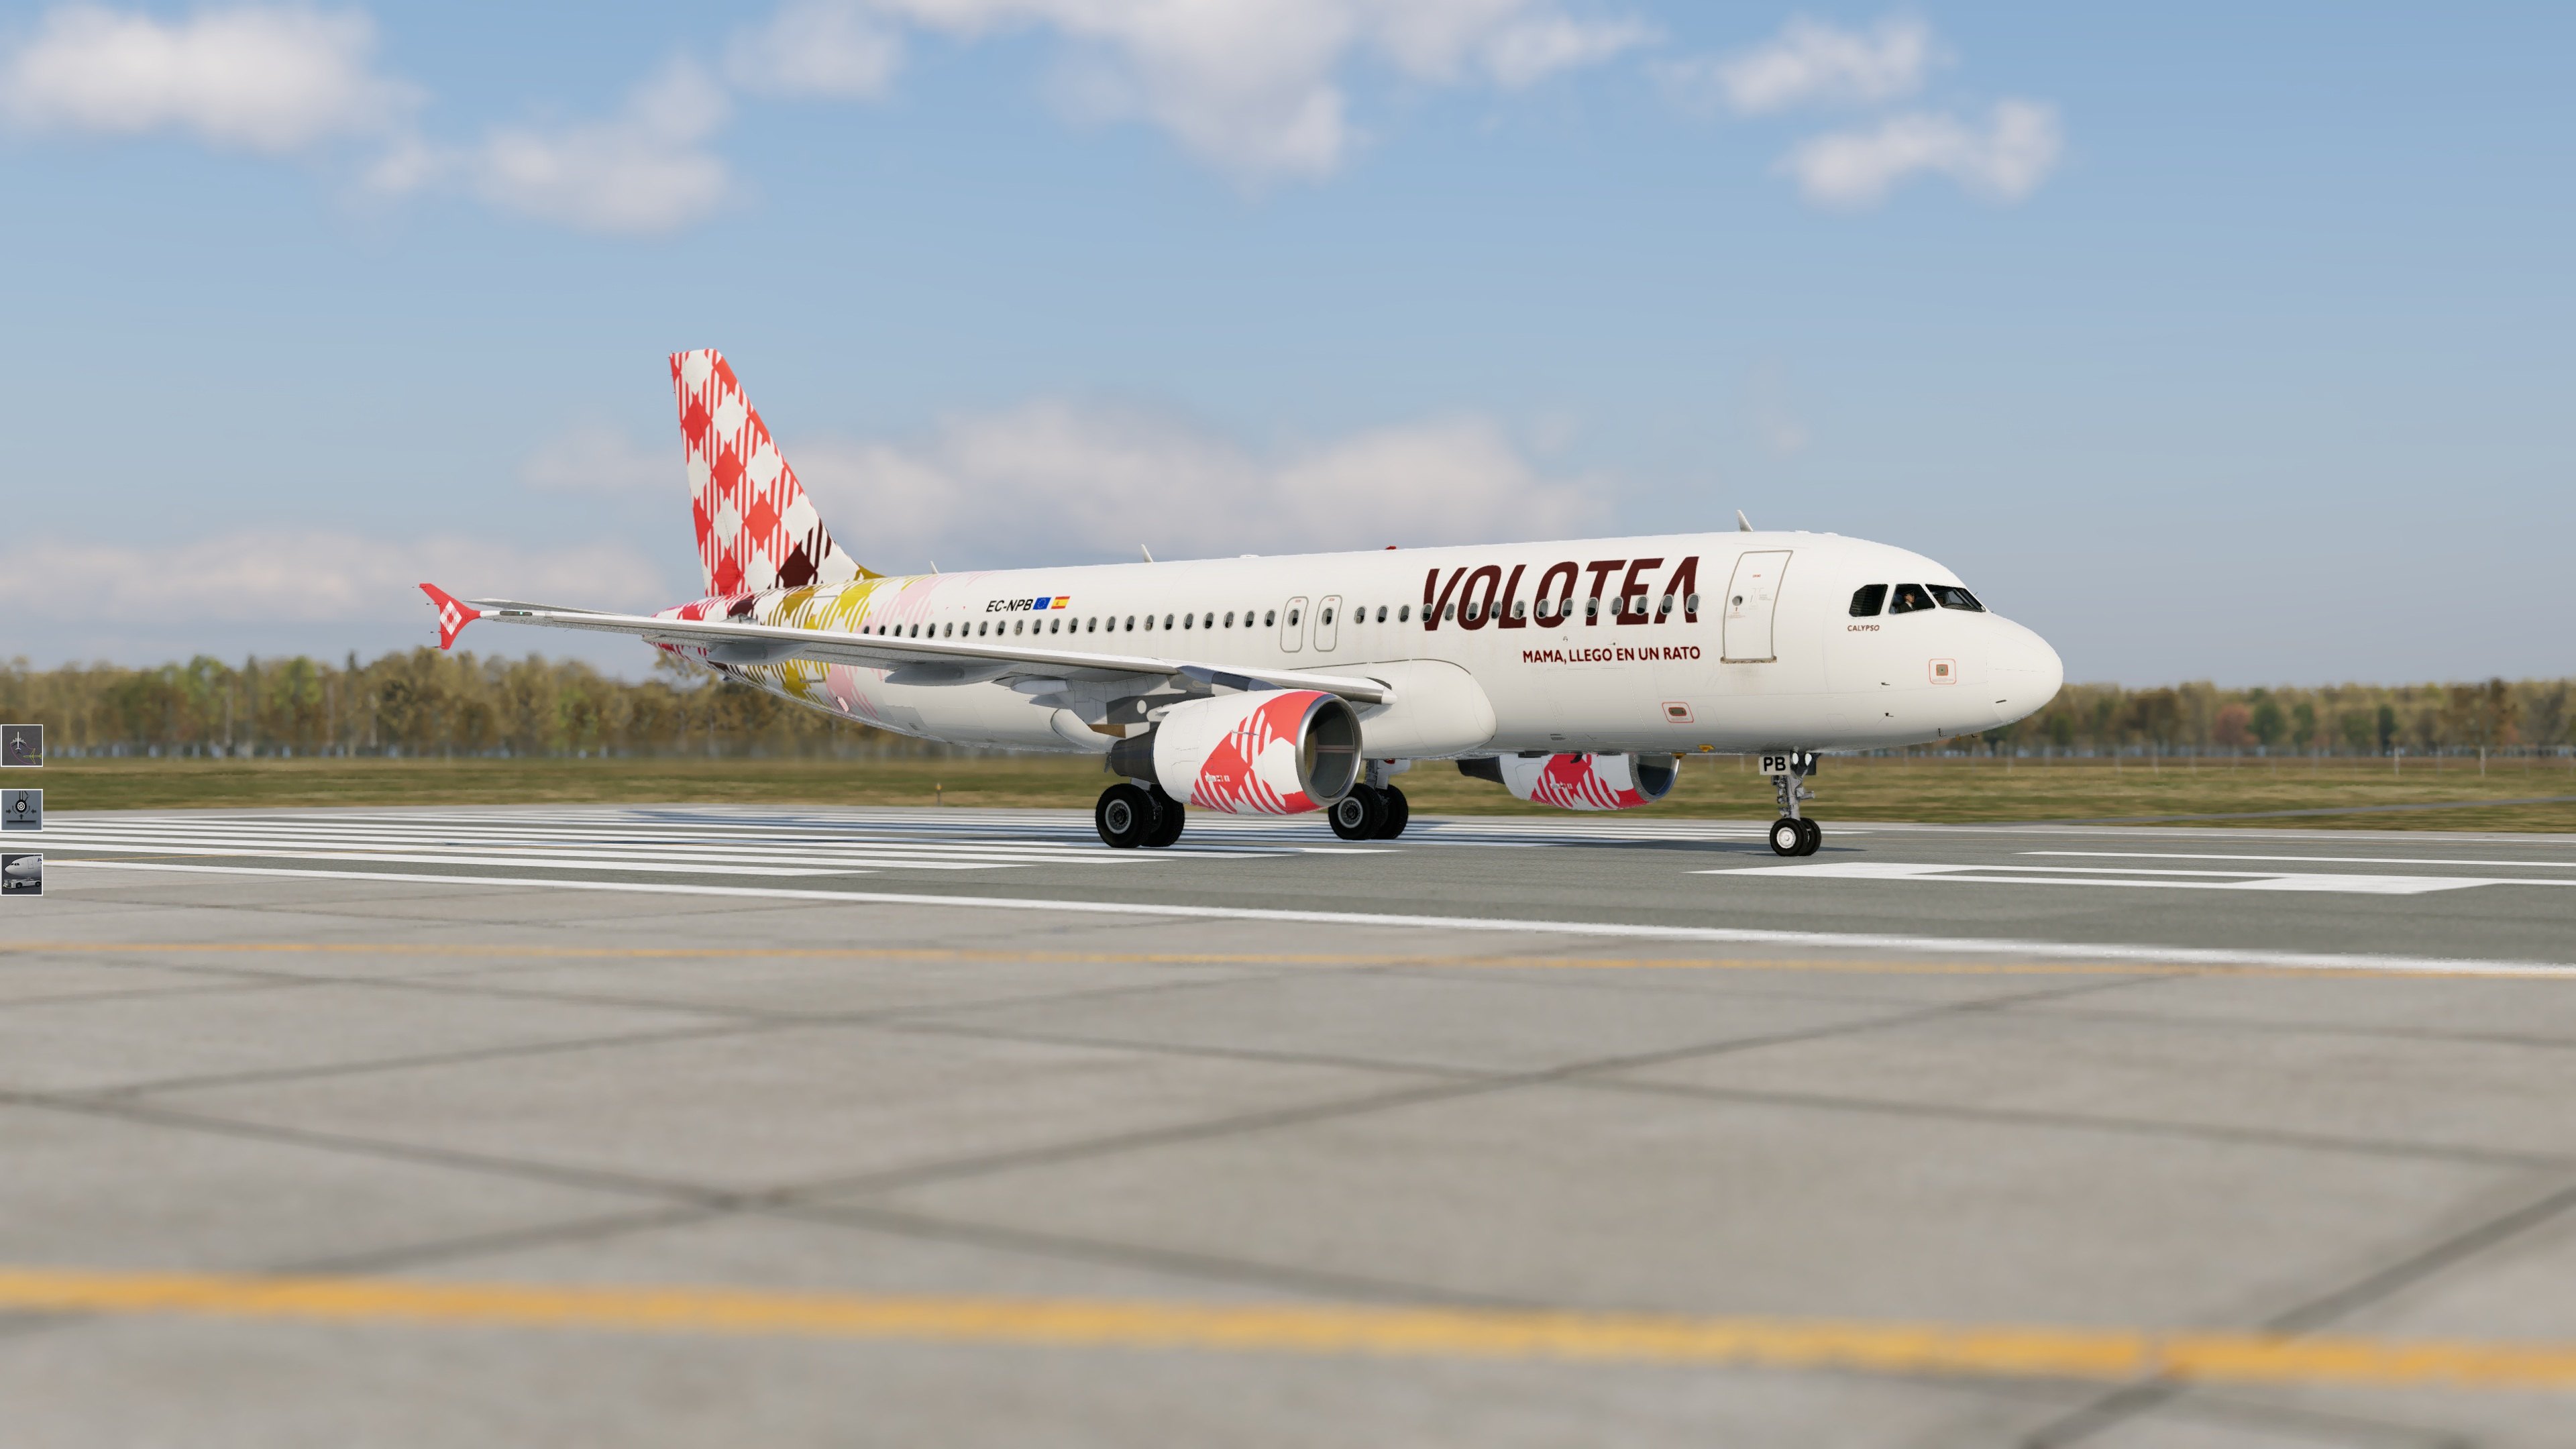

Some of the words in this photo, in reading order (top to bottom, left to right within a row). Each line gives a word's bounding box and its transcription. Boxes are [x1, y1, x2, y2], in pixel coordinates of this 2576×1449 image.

[1424, 556, 1699, 631] VOLOTEA
[985, 599, 1034, 612] EC-NPB
[1523, 649, 1567, 665] MAMA,
[1569, 648, 1613, 662] LLEGO
[1617, 648, 1634, 661] EN
[1639, 647, 1659, 661] UN
[1664, 646, 1701, 660] RATO
[1764, 757, 1786, 771] PB
